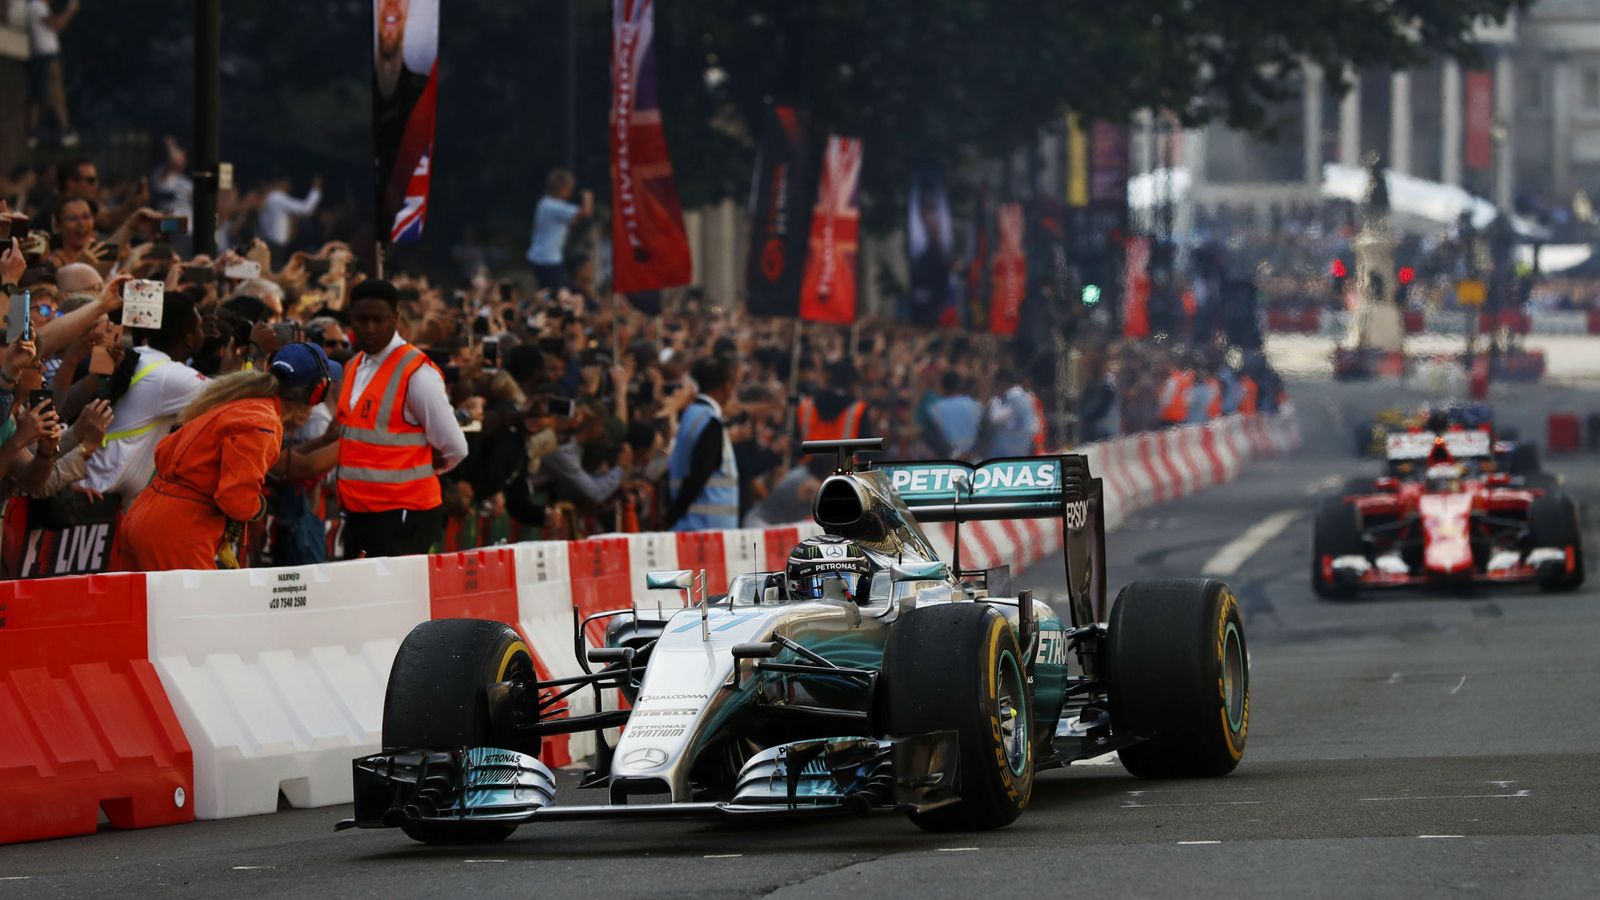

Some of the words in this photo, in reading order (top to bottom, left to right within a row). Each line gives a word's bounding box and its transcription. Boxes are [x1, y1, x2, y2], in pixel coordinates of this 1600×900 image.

[892, 464, 1054, 491] PETRONAS
[1066, 500, 1089, 529] EPSON
[55, 523, 109, 574] LIVE
[815, 562, 857, 571] PETRONAS
[280, 597, 293, 608] 7540
[294, 596, 307, 607] 2500
[1035, 630, 1068, 665] ETRO
[639, 694, 709, 703] QUALCOMM
[627, 728, 685, 739] SYNTIUM
[482, 753, 522, 764] PETRONAS
